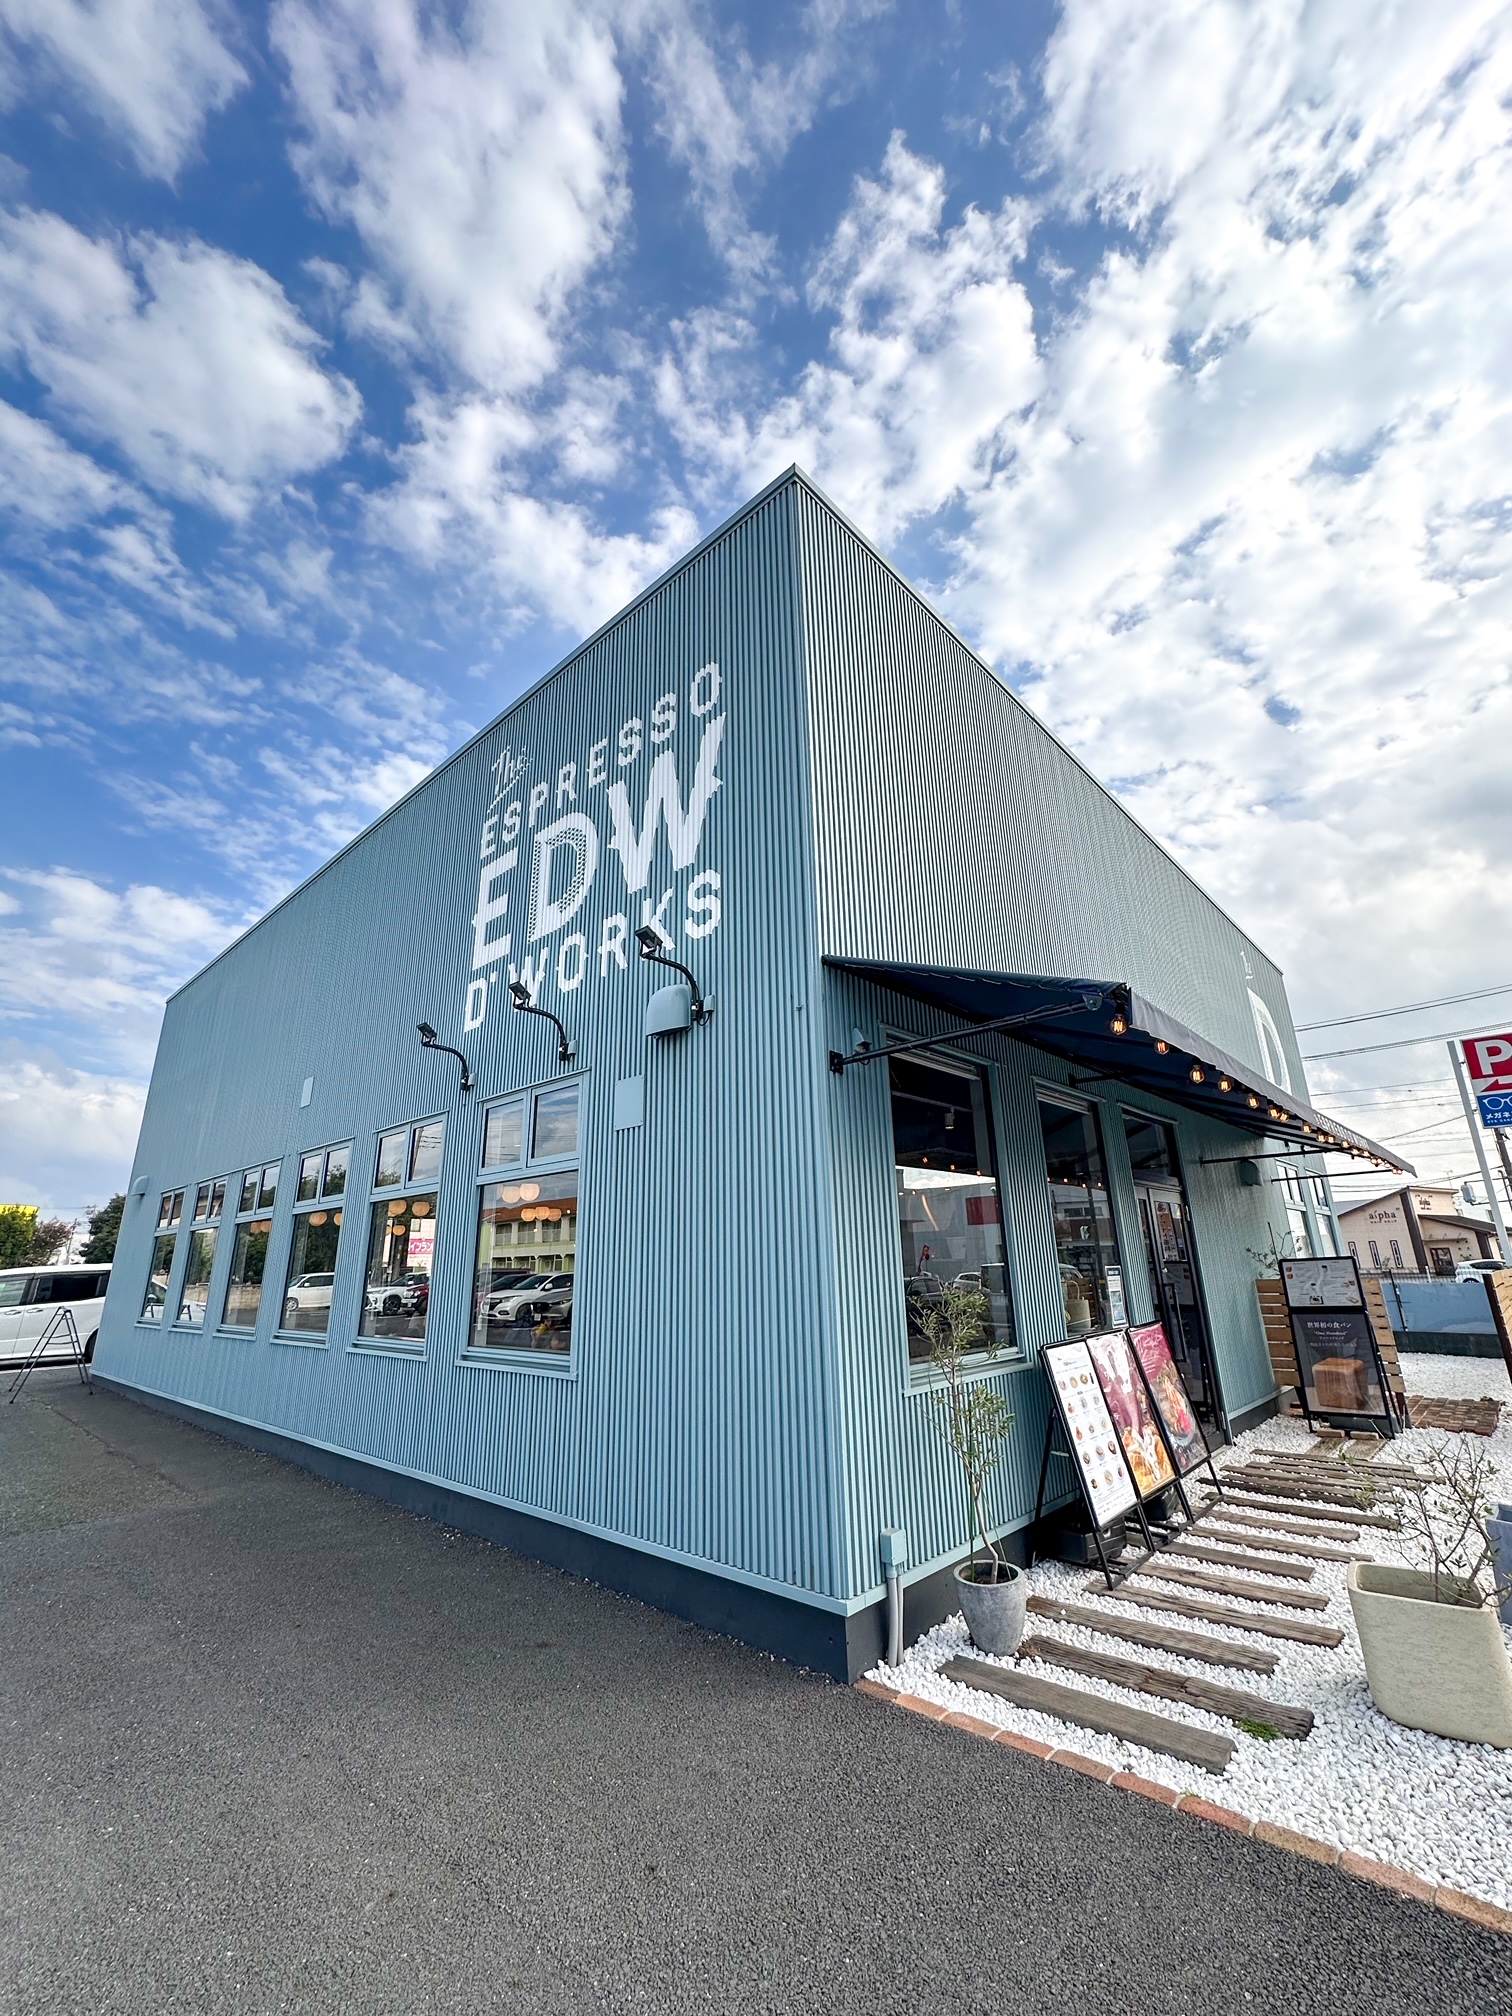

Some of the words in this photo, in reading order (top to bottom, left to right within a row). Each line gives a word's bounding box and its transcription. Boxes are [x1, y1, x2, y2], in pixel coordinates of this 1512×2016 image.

[480, 661, 722, 861] ESPRESSO
[471, 711, 726, 971] EDW
[1246, 986, 1293, 1098] D
[1474, 1039, 1512, 1076] P
[1485, 1110, 1512, 1120] メガネ
